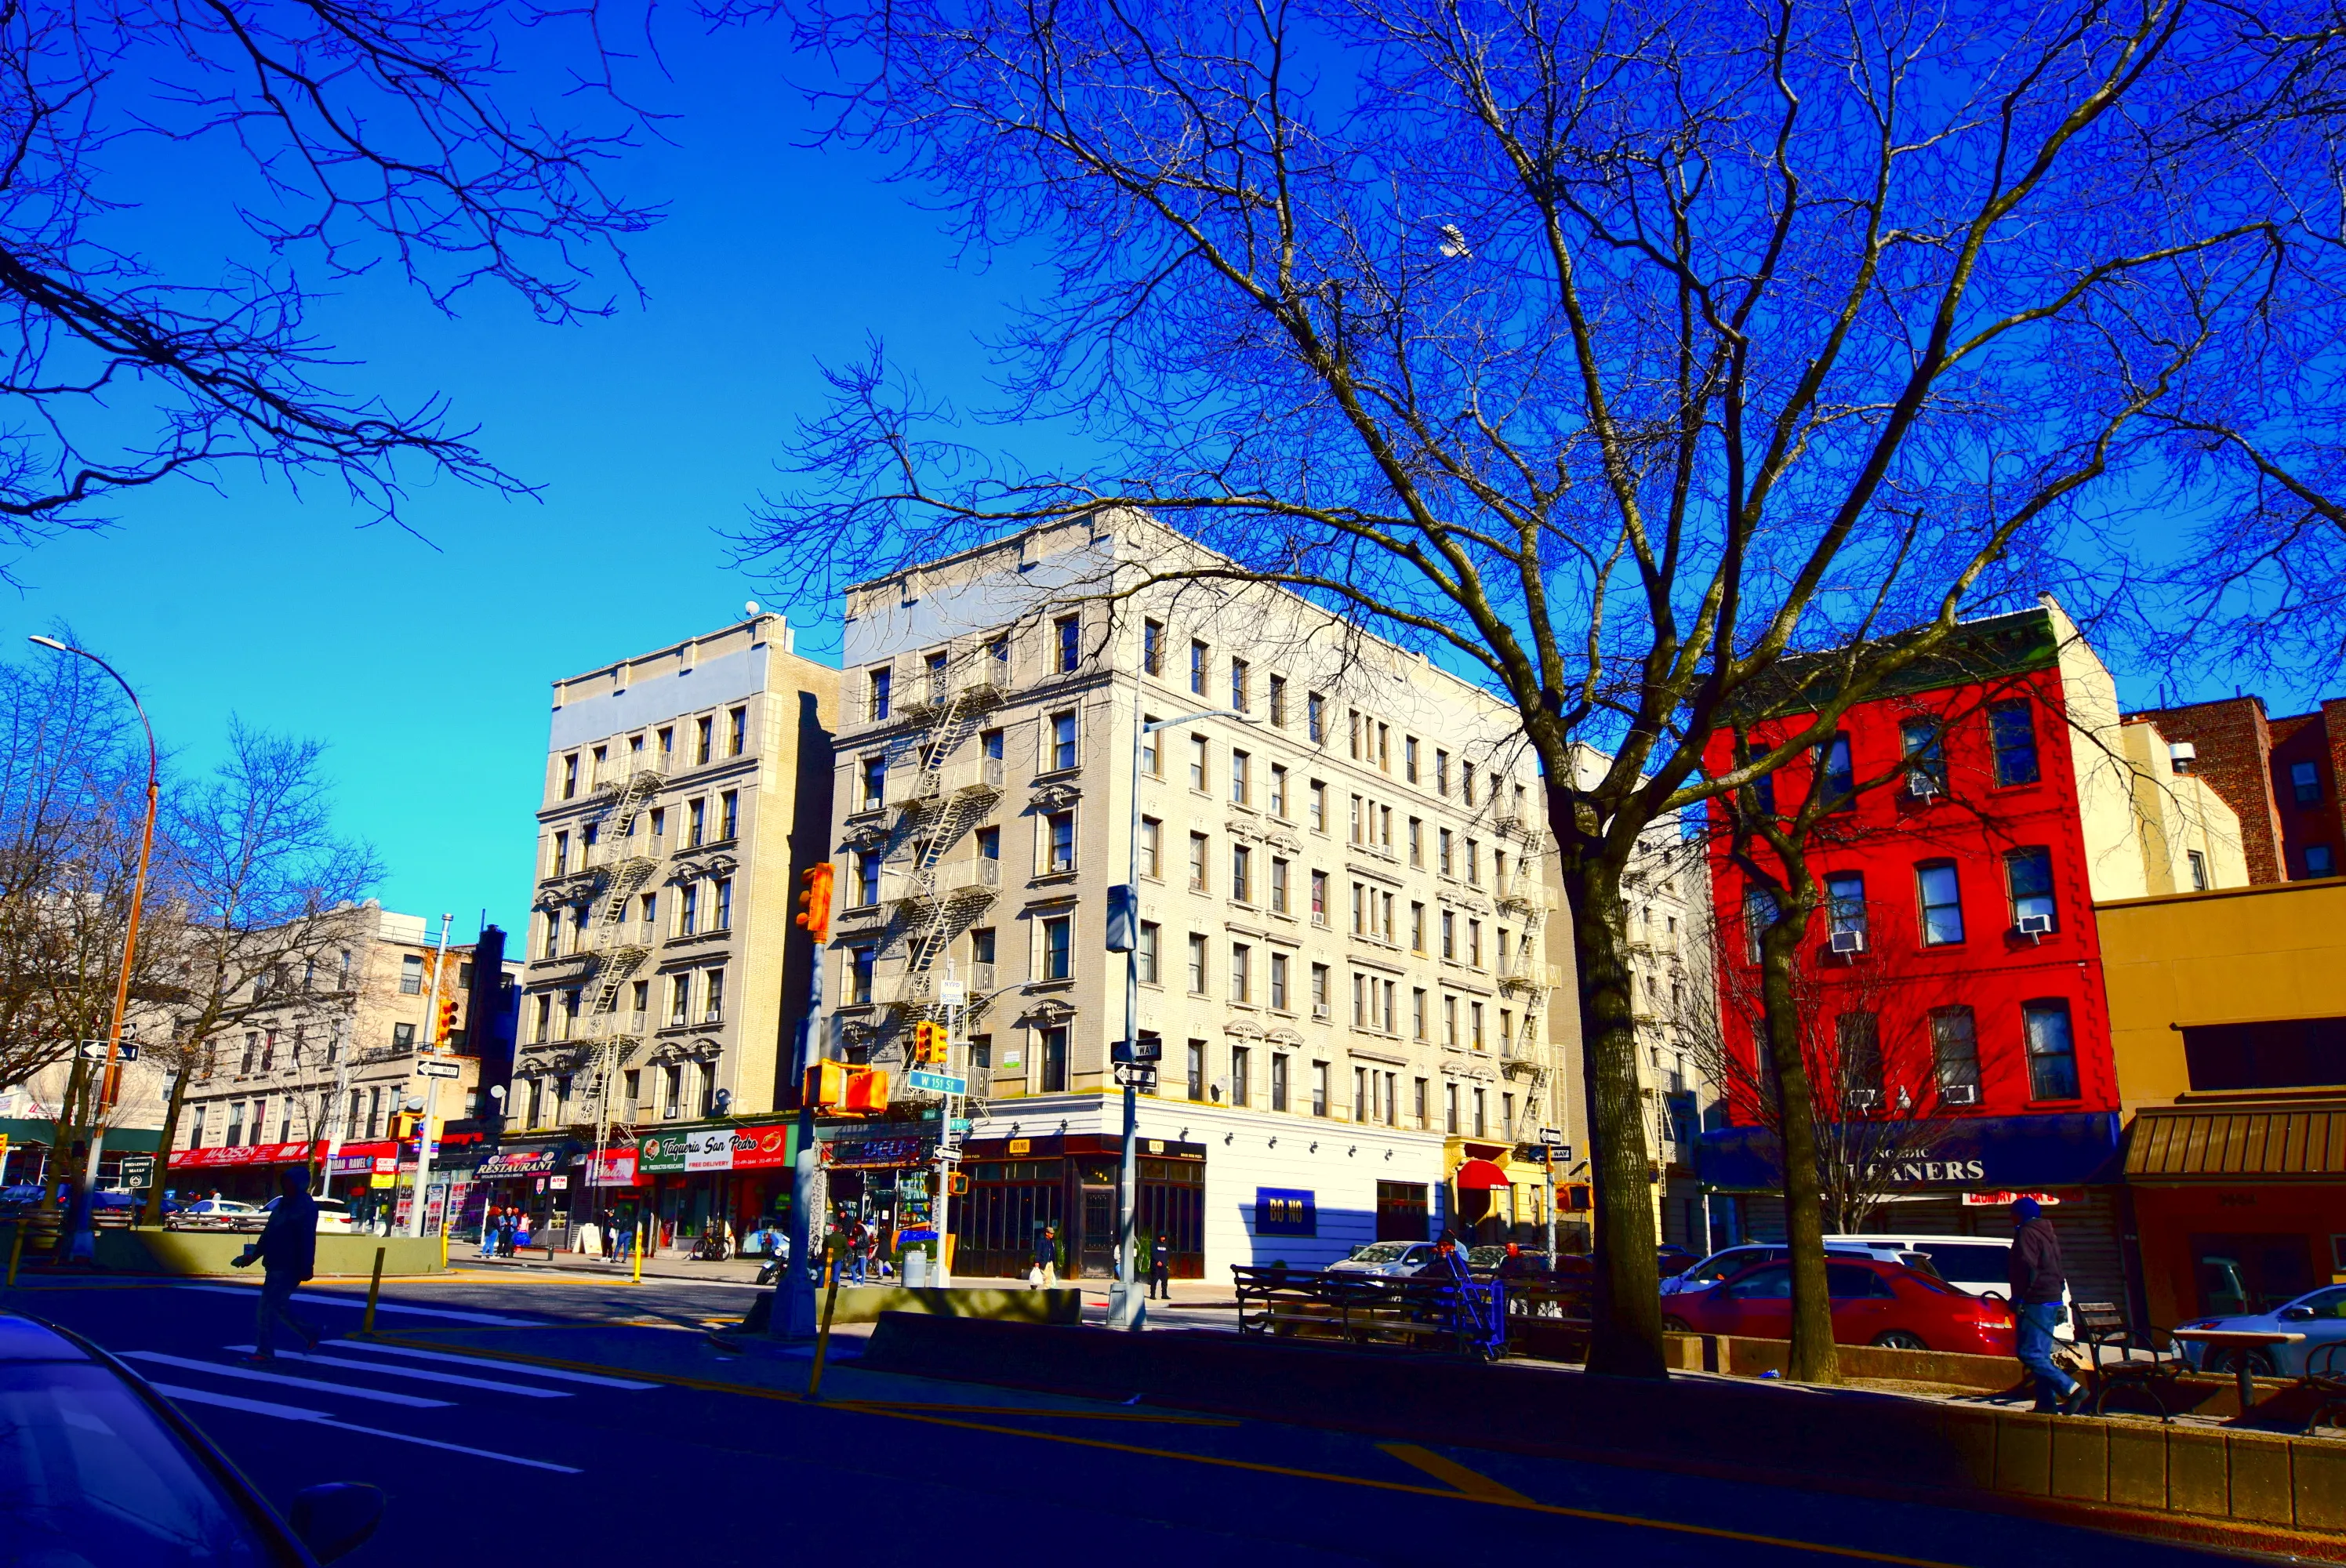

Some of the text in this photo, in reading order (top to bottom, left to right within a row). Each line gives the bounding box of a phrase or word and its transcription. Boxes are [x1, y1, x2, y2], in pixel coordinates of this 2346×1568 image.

[1138, 1046, 1155, 1055] WAY
[1120, 1069, 1153, 1081] ONE WAY
[921, 1076, 954, 1091] W 151 St
[204, 1145, 255, 1159] MADISON
[278, 1145, 301, 1157] MRI
[663, 1133, 758, 1162] Taqueria San Pedro
[476, 1160, 556, 1174] RESTAURANT
